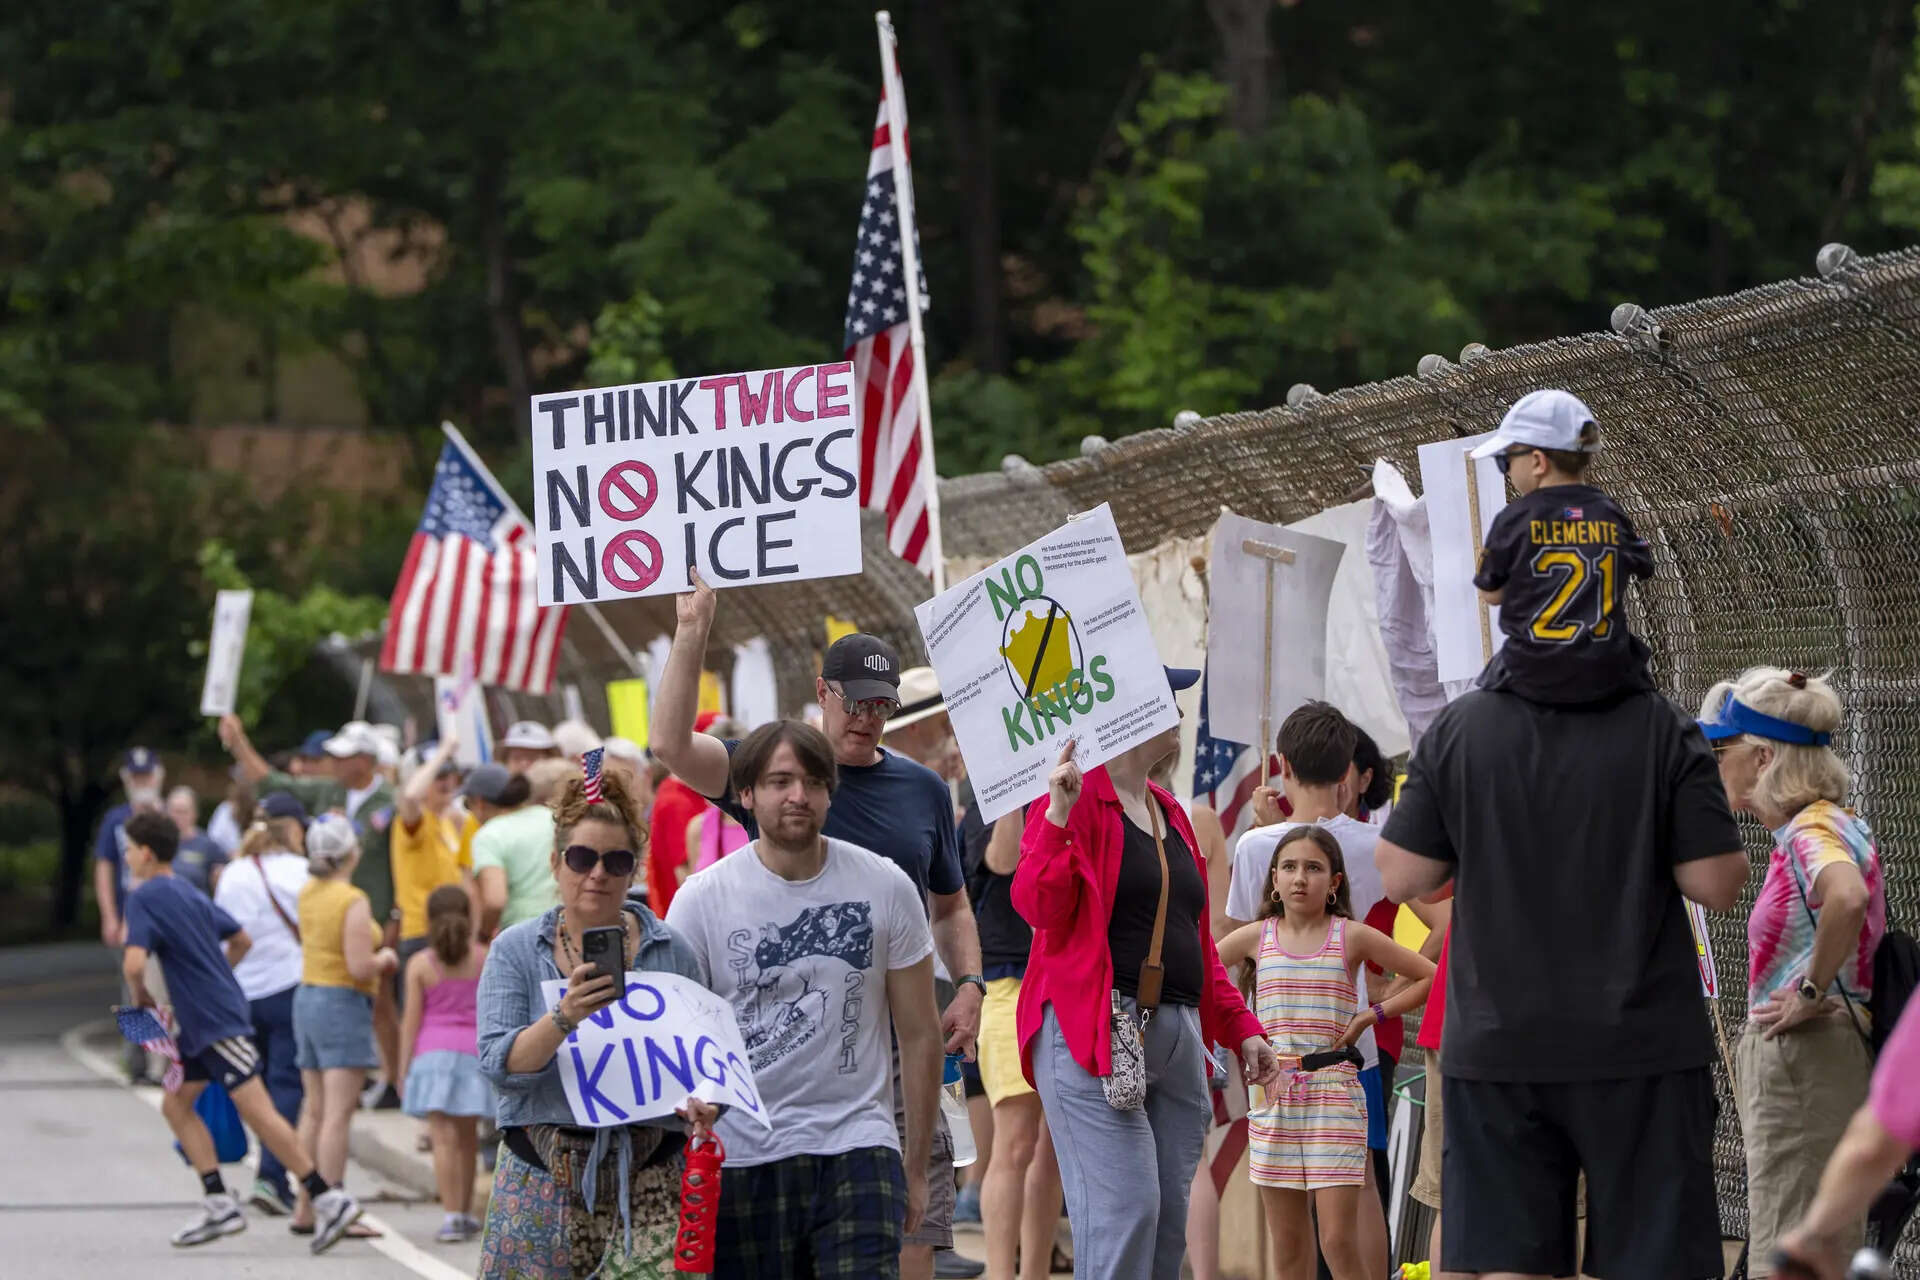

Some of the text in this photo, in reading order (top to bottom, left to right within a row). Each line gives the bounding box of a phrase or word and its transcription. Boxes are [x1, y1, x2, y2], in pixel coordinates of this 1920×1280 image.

[538, 362, 852, 450] THINK TWICE
[674, 428, 857, 513] KINGS
[684, 509, 799, 586] ICE
[1530, 520, 1619, 544] CLEMENTE
[985, 554, 1043, 621] NO
[1529, 547, 1618, 643] 21
[1002, 655, 1115, 752] KINGS
[838, 971, 866, 1075] 2021
[570, 1035, 759, 1123] KINGS
